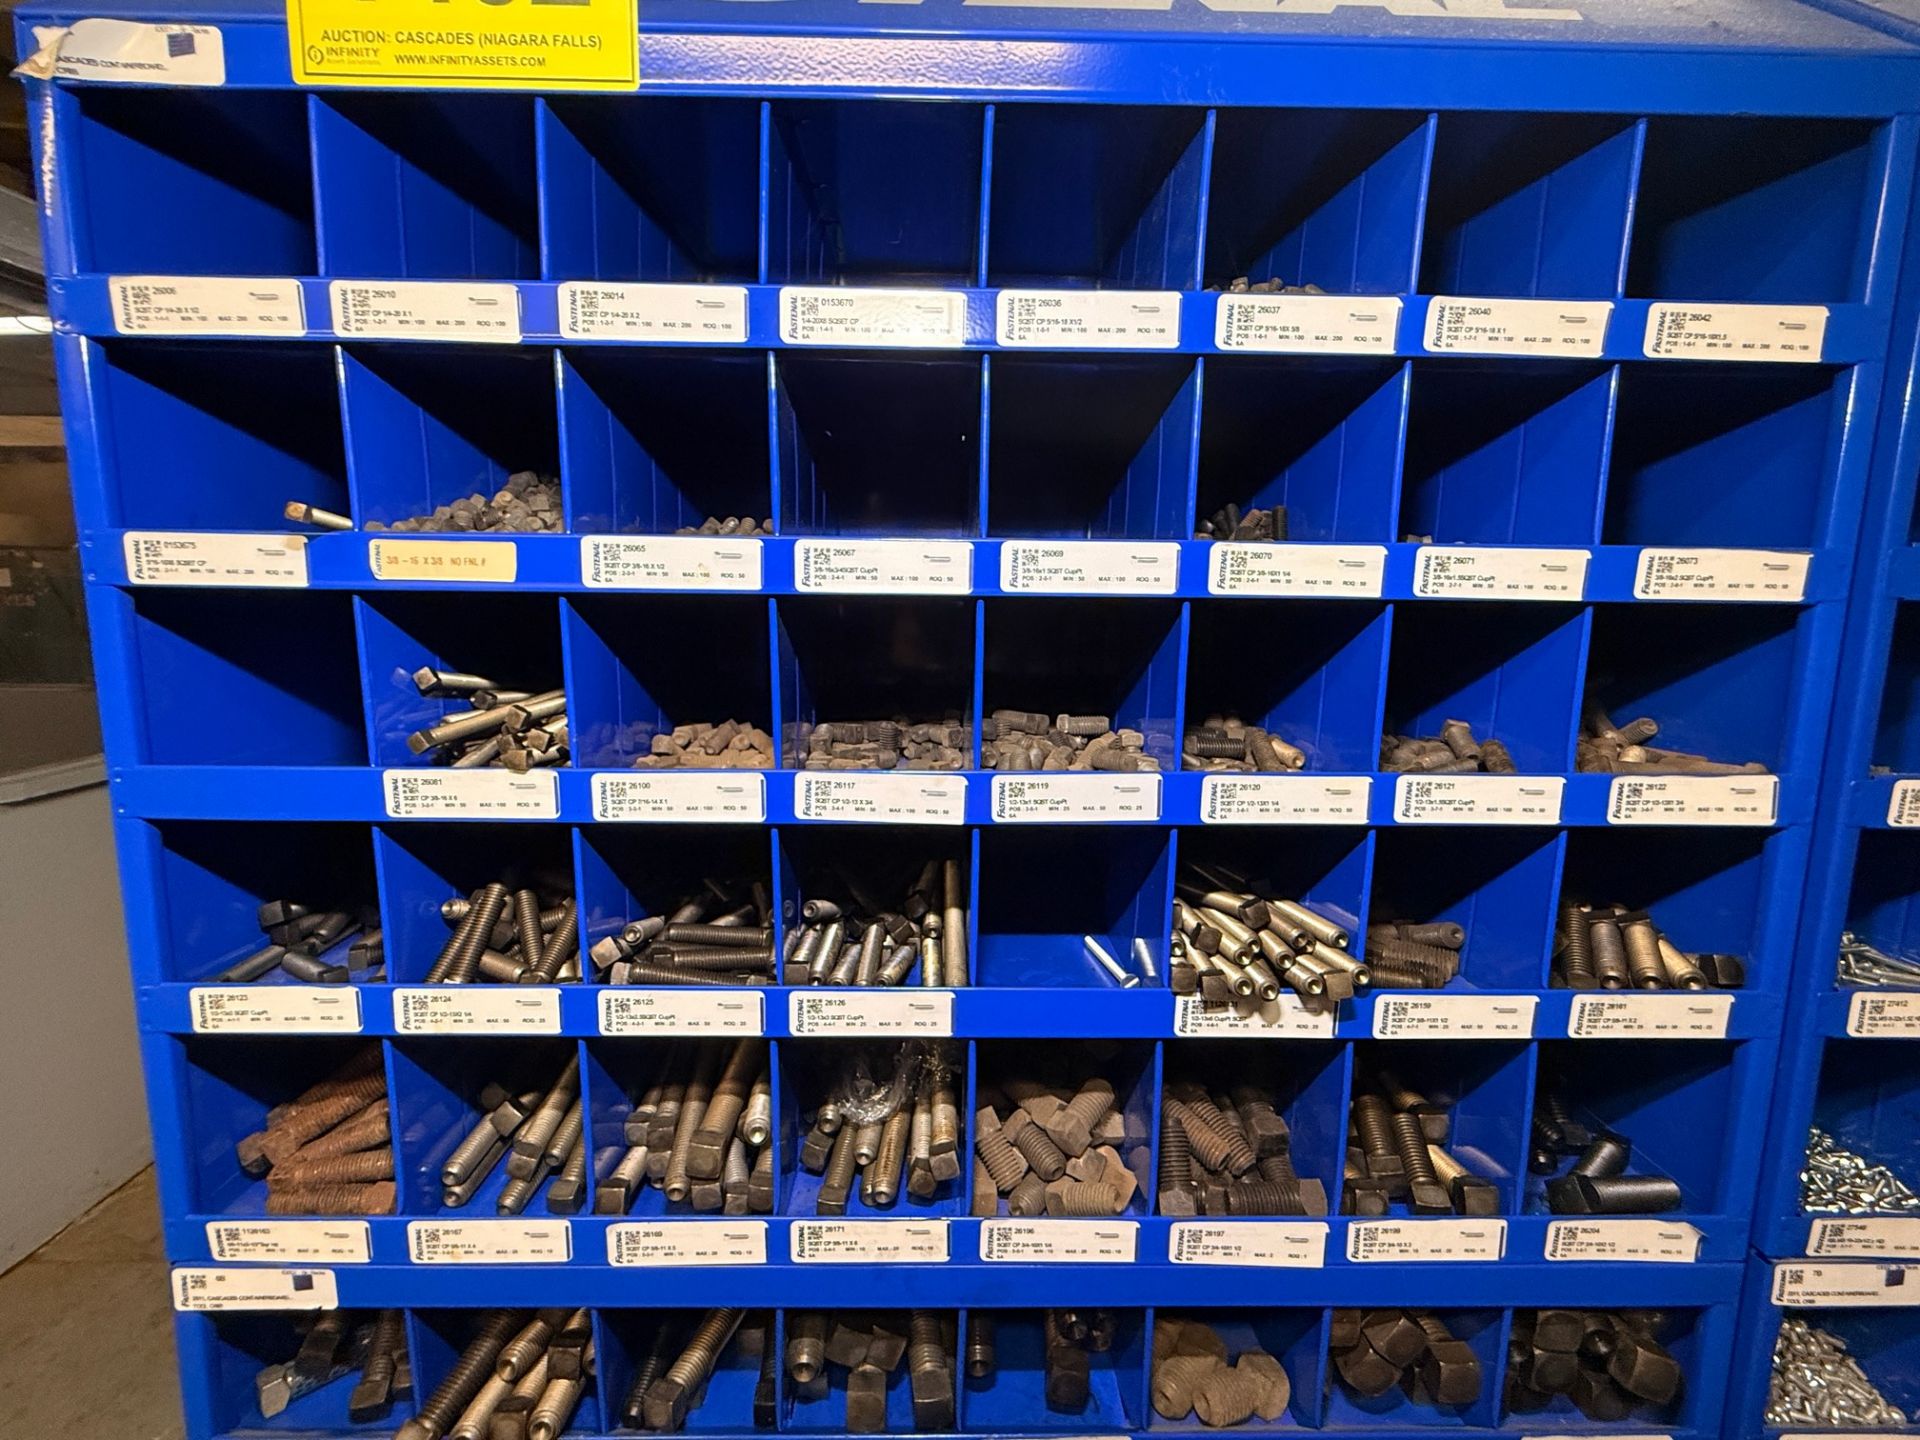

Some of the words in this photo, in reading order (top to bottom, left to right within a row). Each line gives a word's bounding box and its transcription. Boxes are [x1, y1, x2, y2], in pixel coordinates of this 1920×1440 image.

[320, 29, 391, 44] AUCTION:
[395, 31, 474, 46] CASCADES
[479, 32, 549, 49] (NIAGARA
[553, 34, 602, 50] FALLS)
[326, 48, 380, 58] INFINITY
[395, 53, 546, 68] WWW.INFINITYASSETS.COM
[601, 291, 625, 300] 26014
[821, 298, 853, 306] 0153670
[1038, 299, 1061, 307] 26036
[569, 289, 578, 333] FASTENAL
[789, 296, 798, 339] FASTENAL
[1258, 306, 1280, 314] 26037
[1223, 304, 1234, 346] FASTENAL
[450, 558, 461, 566] NO
[592, 542, 601, 582] FASTENAL
[1250, 552, 1272, 560] 26070
[1453, 557, 1474, 565] 26071
[802, 547, 811, 587] FASTENAL
[1010, 548, 1019, 588] FASTENAL
[1217, 550, 1228, 589] FASTENAL
[997, 782, 1006, 818] FASTENAL
